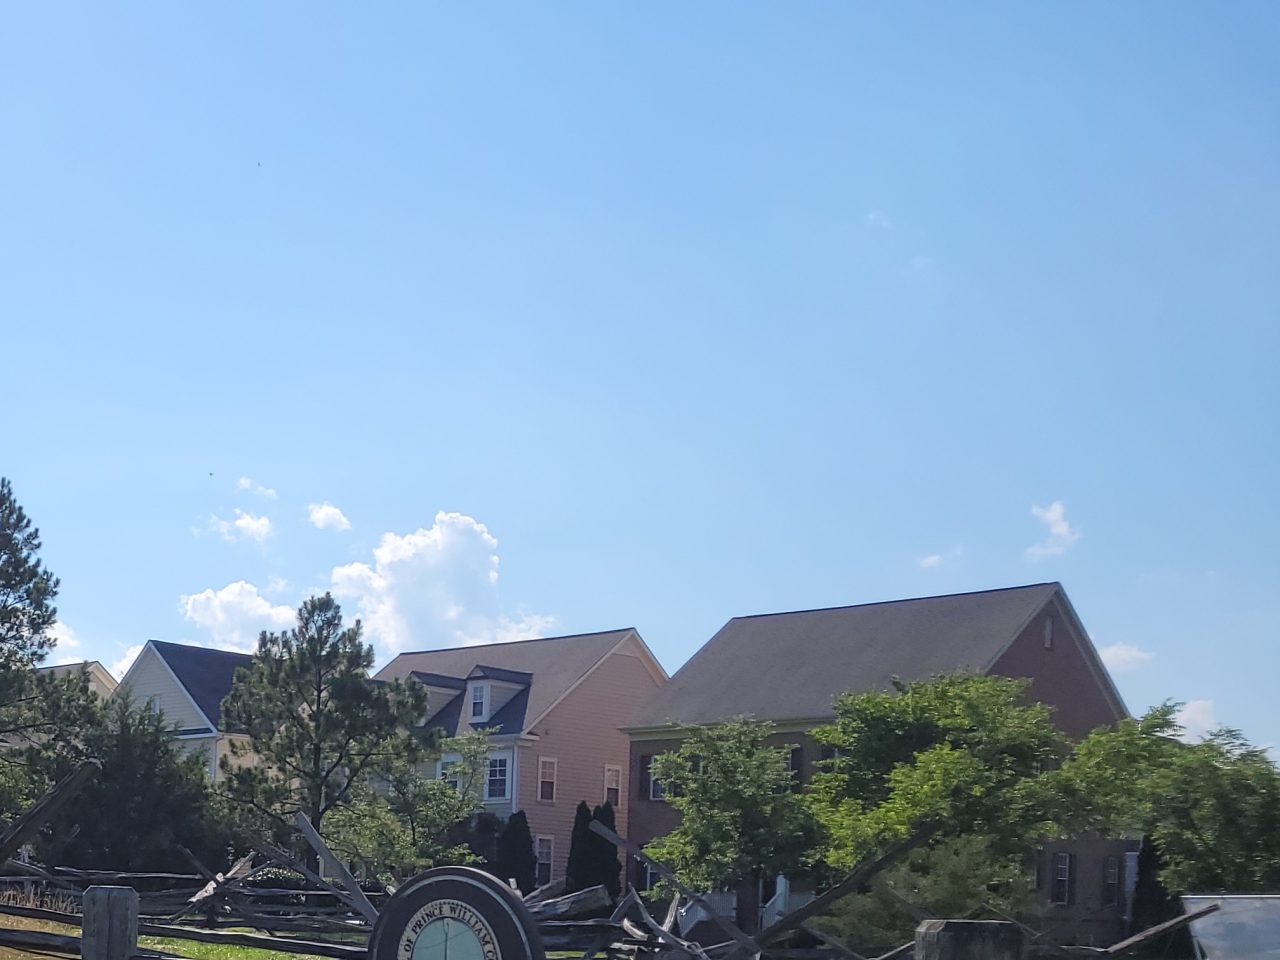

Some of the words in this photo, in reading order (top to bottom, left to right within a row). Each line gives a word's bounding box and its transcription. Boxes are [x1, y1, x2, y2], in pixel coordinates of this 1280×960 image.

[404, 938, 415, 952] OF
[412, 905, 444, 934] PRINCE
[449, 905, 492, 947] WILLIAM
